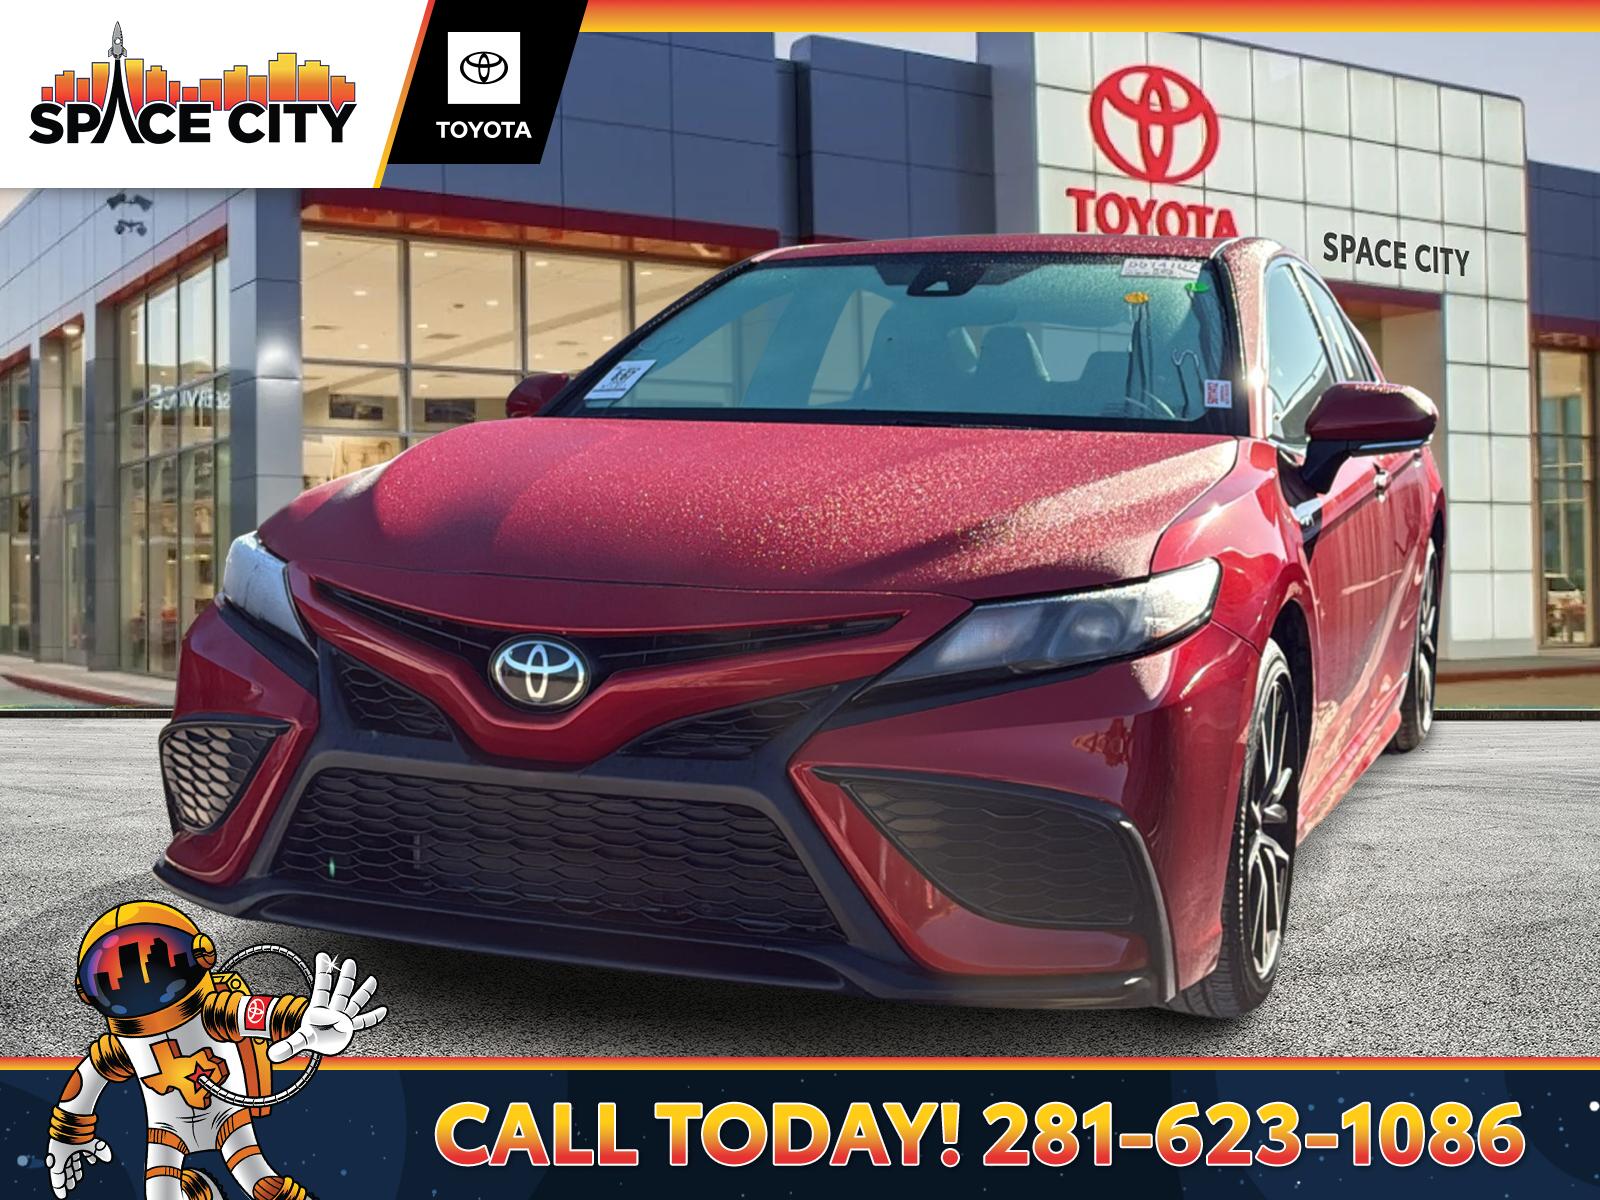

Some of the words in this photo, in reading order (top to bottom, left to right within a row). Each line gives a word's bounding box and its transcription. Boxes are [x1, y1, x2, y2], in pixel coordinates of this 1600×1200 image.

[1066, 188, 1238, 238] TOYOTA
[1323, 232, 1407, 269] SPACE
[1415, 244, 1470, 276] CITY
